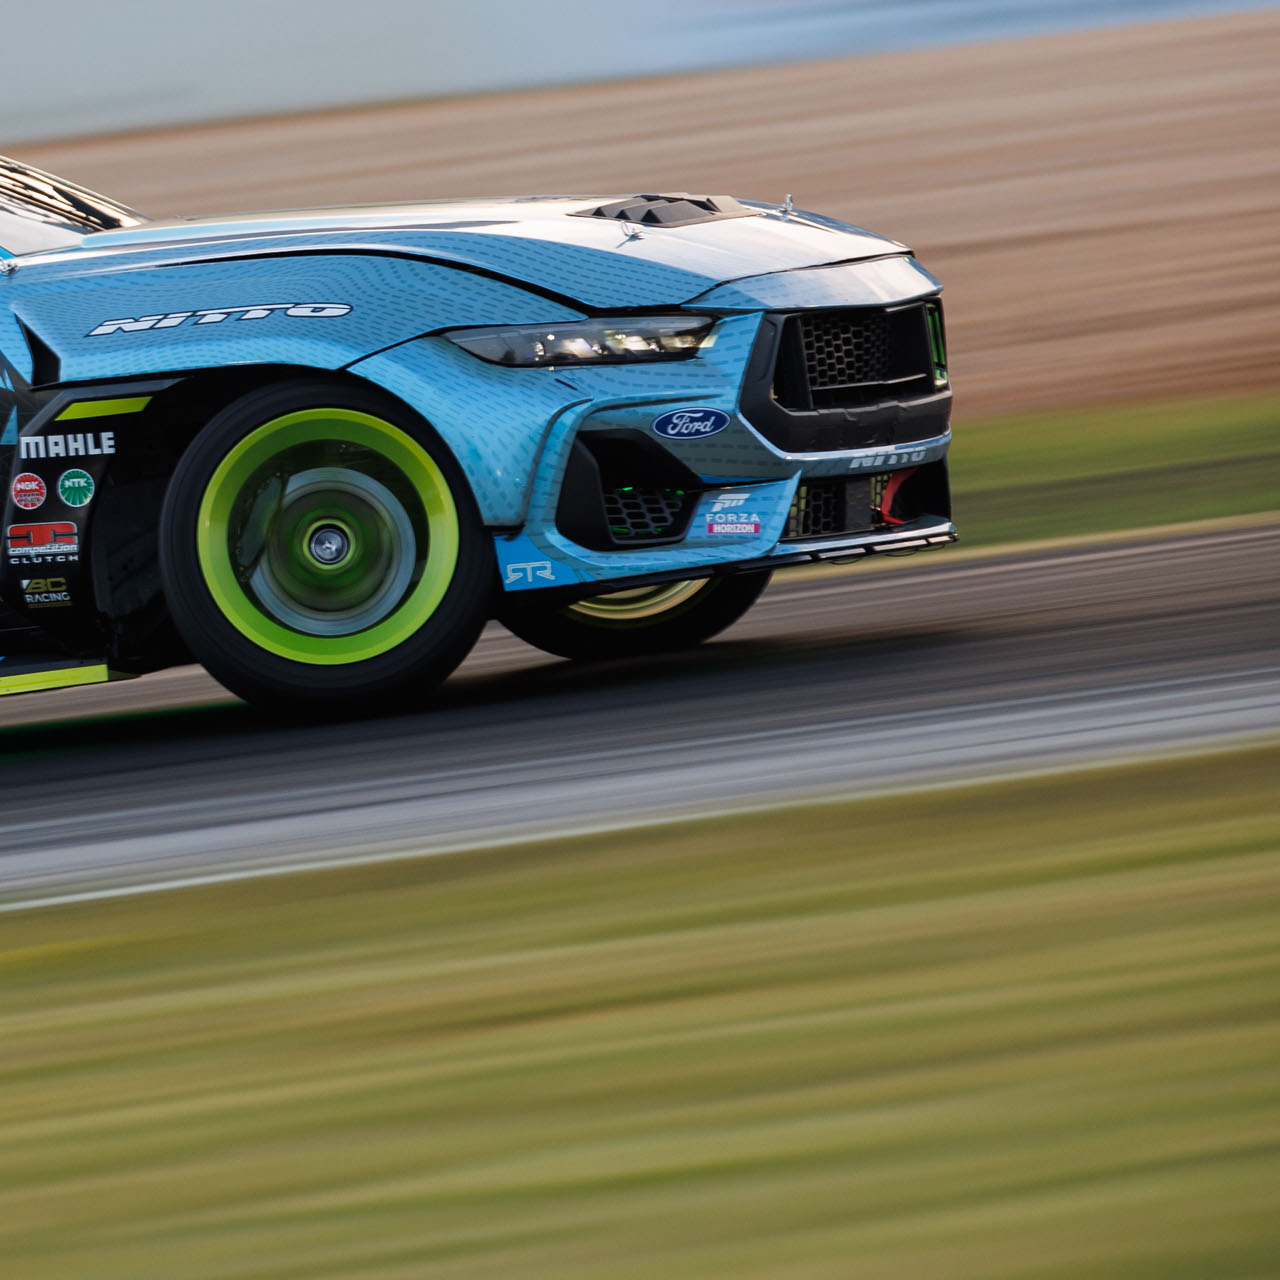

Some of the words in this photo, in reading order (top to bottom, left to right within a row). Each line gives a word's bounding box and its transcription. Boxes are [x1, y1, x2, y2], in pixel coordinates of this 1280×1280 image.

[84, 302, 354, 338] NITTO
[667, 411, 715, 434] Ford
[19, 431, 116, 459] MAHLE
[16, 481, 40, 491] NGK
[64, 478, 88, 488] NTK
[705, 512, 761, 524] FORZA
[713, 523, 756, 534] HORIZON
[8, 543, 78, 556] competition
[9, 555, 78, 564] CLUTCH
[504, 560, 556, 585] RTR
[25, 576, 68, 593] BC
[25, 592, 70, 603] RACING
